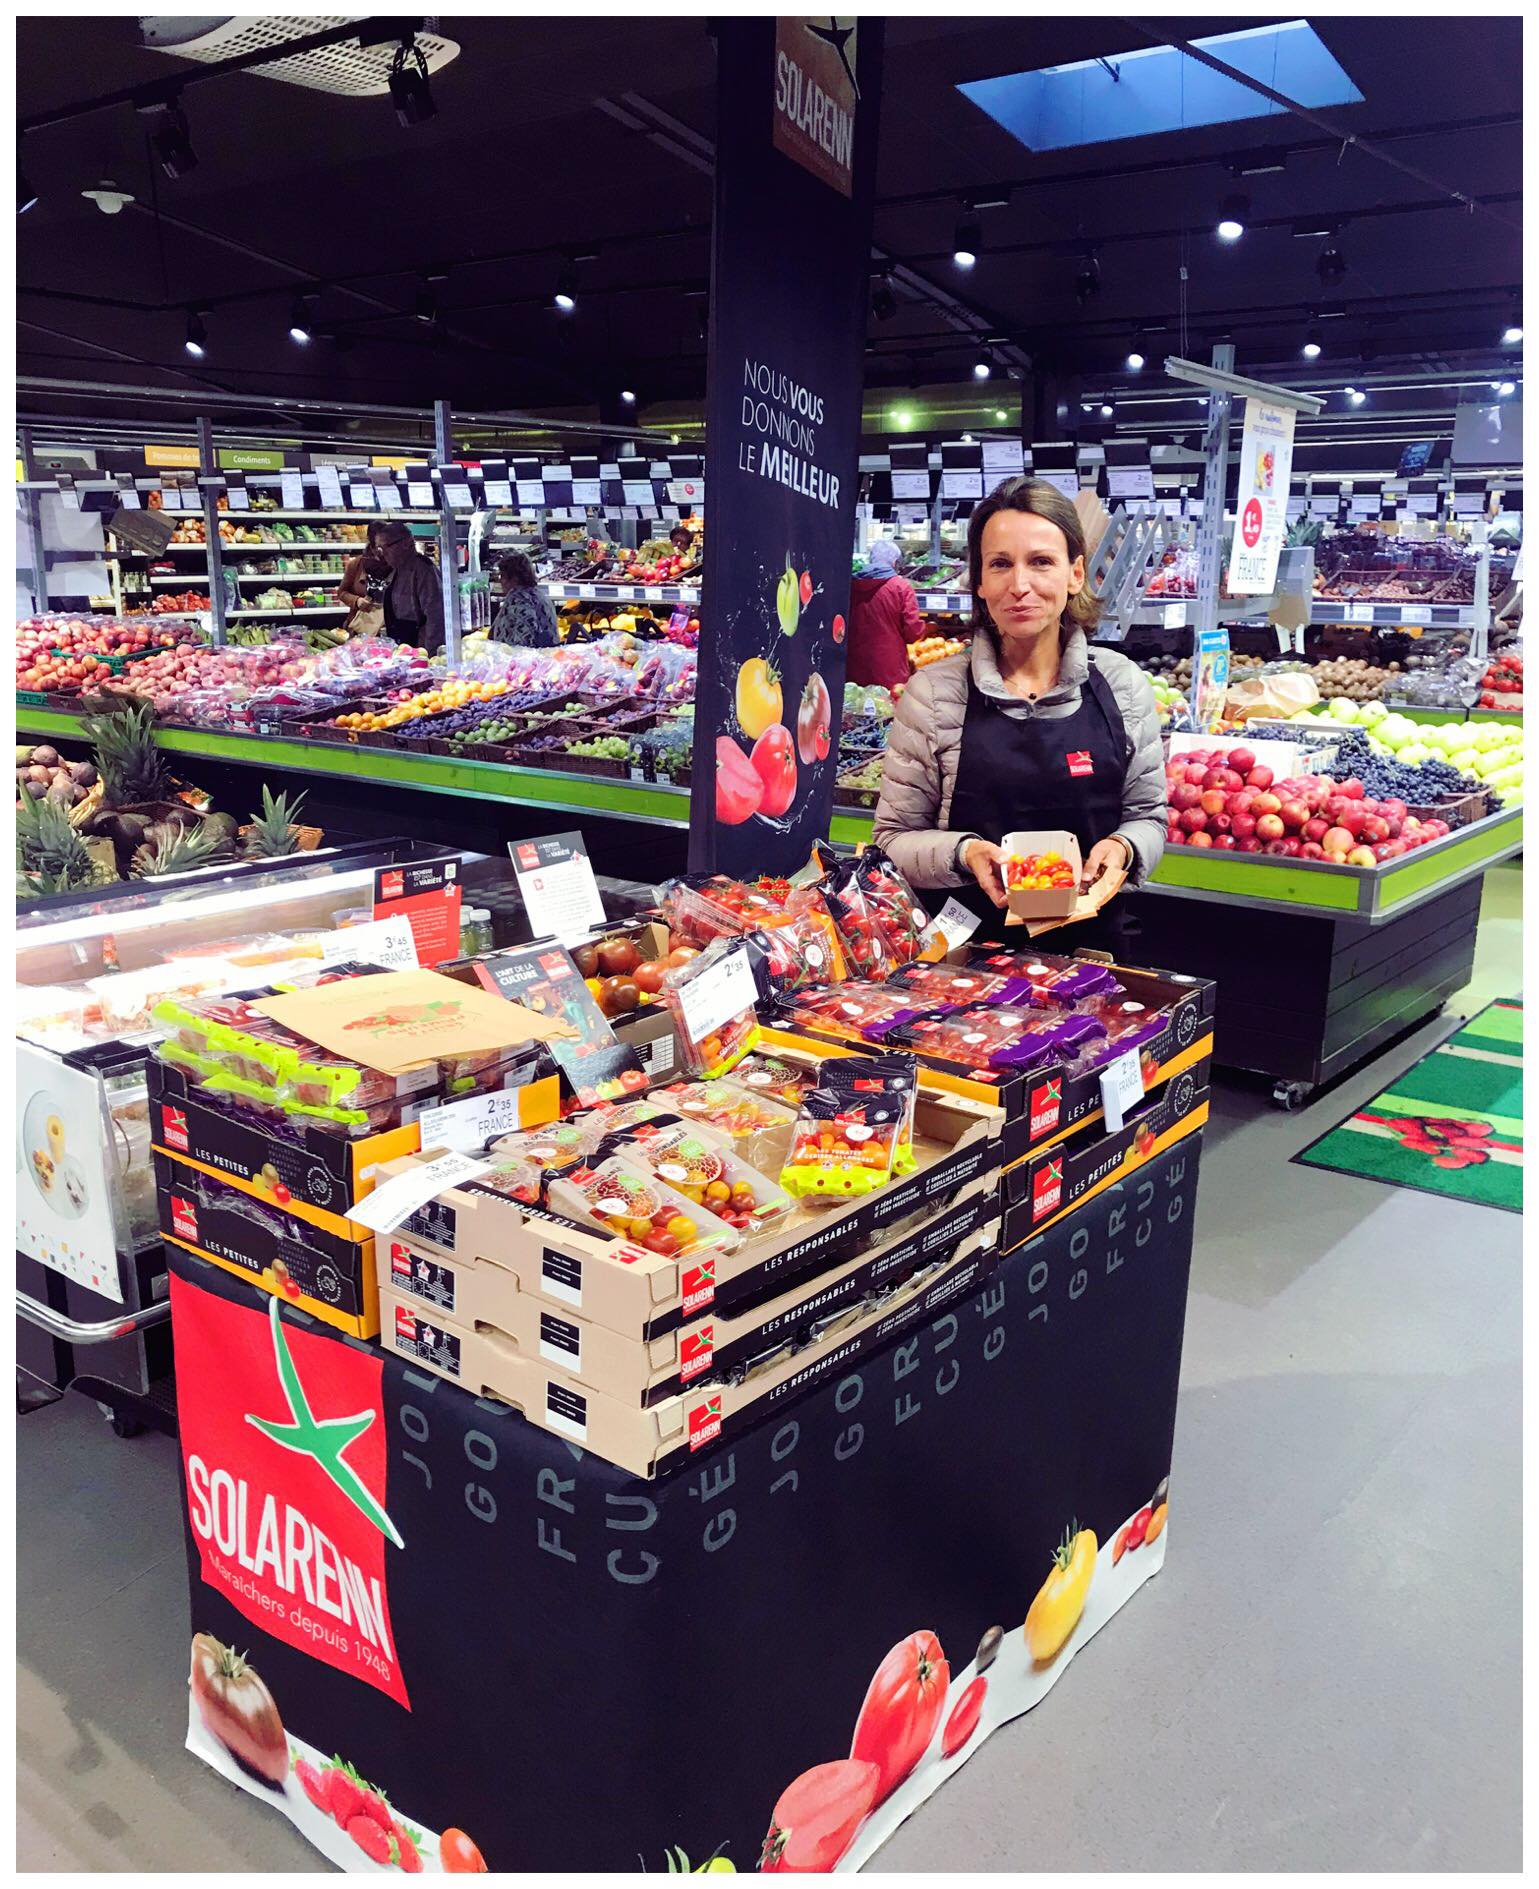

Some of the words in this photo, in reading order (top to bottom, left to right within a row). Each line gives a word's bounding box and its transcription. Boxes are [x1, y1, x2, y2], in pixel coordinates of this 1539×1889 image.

[776, 50, 853, 170] SOLARENN
[745, 357, 787, 403] NOUS
[790, 380, 824, 425] VOUS
[742, 396, 815, 456] DONNONS
[232, 455, 271, 465] Condiments
[739, 442, 756, 473] LE
[760, 442, 840, 509] MEILLEUR
[379, 948, 412, 965] FRANCE
[514, 965, 524, 974] DE
[499, 969, 539, 985] CULTURE
[479, 1112, 513, 1136] FRANCE
[1030, 1105, 1060, 1132] SOLARENN
[1068, 1103, 1085, 1121] LES
[195, 1148, 211, 1161] LES
[213, 1154, 249, 1176] PETITES
[1069, 1180, 1085, 1200] LES
[1088, 1151, 1123, 1184] PETITES
[1033, 1184, 1061, 1213] SOLARENN
[554, 1217, 577, 1229] LES
[205, 1239, 220, 1253] LES
[223, 1248, 259, 1269] PETITES
[765, 1256, 783, 1272] LES
[786, 1218, 859, 1262] RESPONSABLES
[683, 1284, 715, 1309] SOLARENN
[762, 1319, 781, 1336] LES
[784, 1278, 856, 1325] RESPONSABLES
[681, 1350, 713, 1376] SOLARENN
[770, 1383, 788, 1400] LES
[790, 1339, 862, 1388] RESPONSABLES
[690, 1419, 721, 1446] SOLARENN
[187, 1454, 394, 1663] SOLARENN
[290, 1607, 348, 1653] depuis
[354, 1641, 391, 1681] 1948
